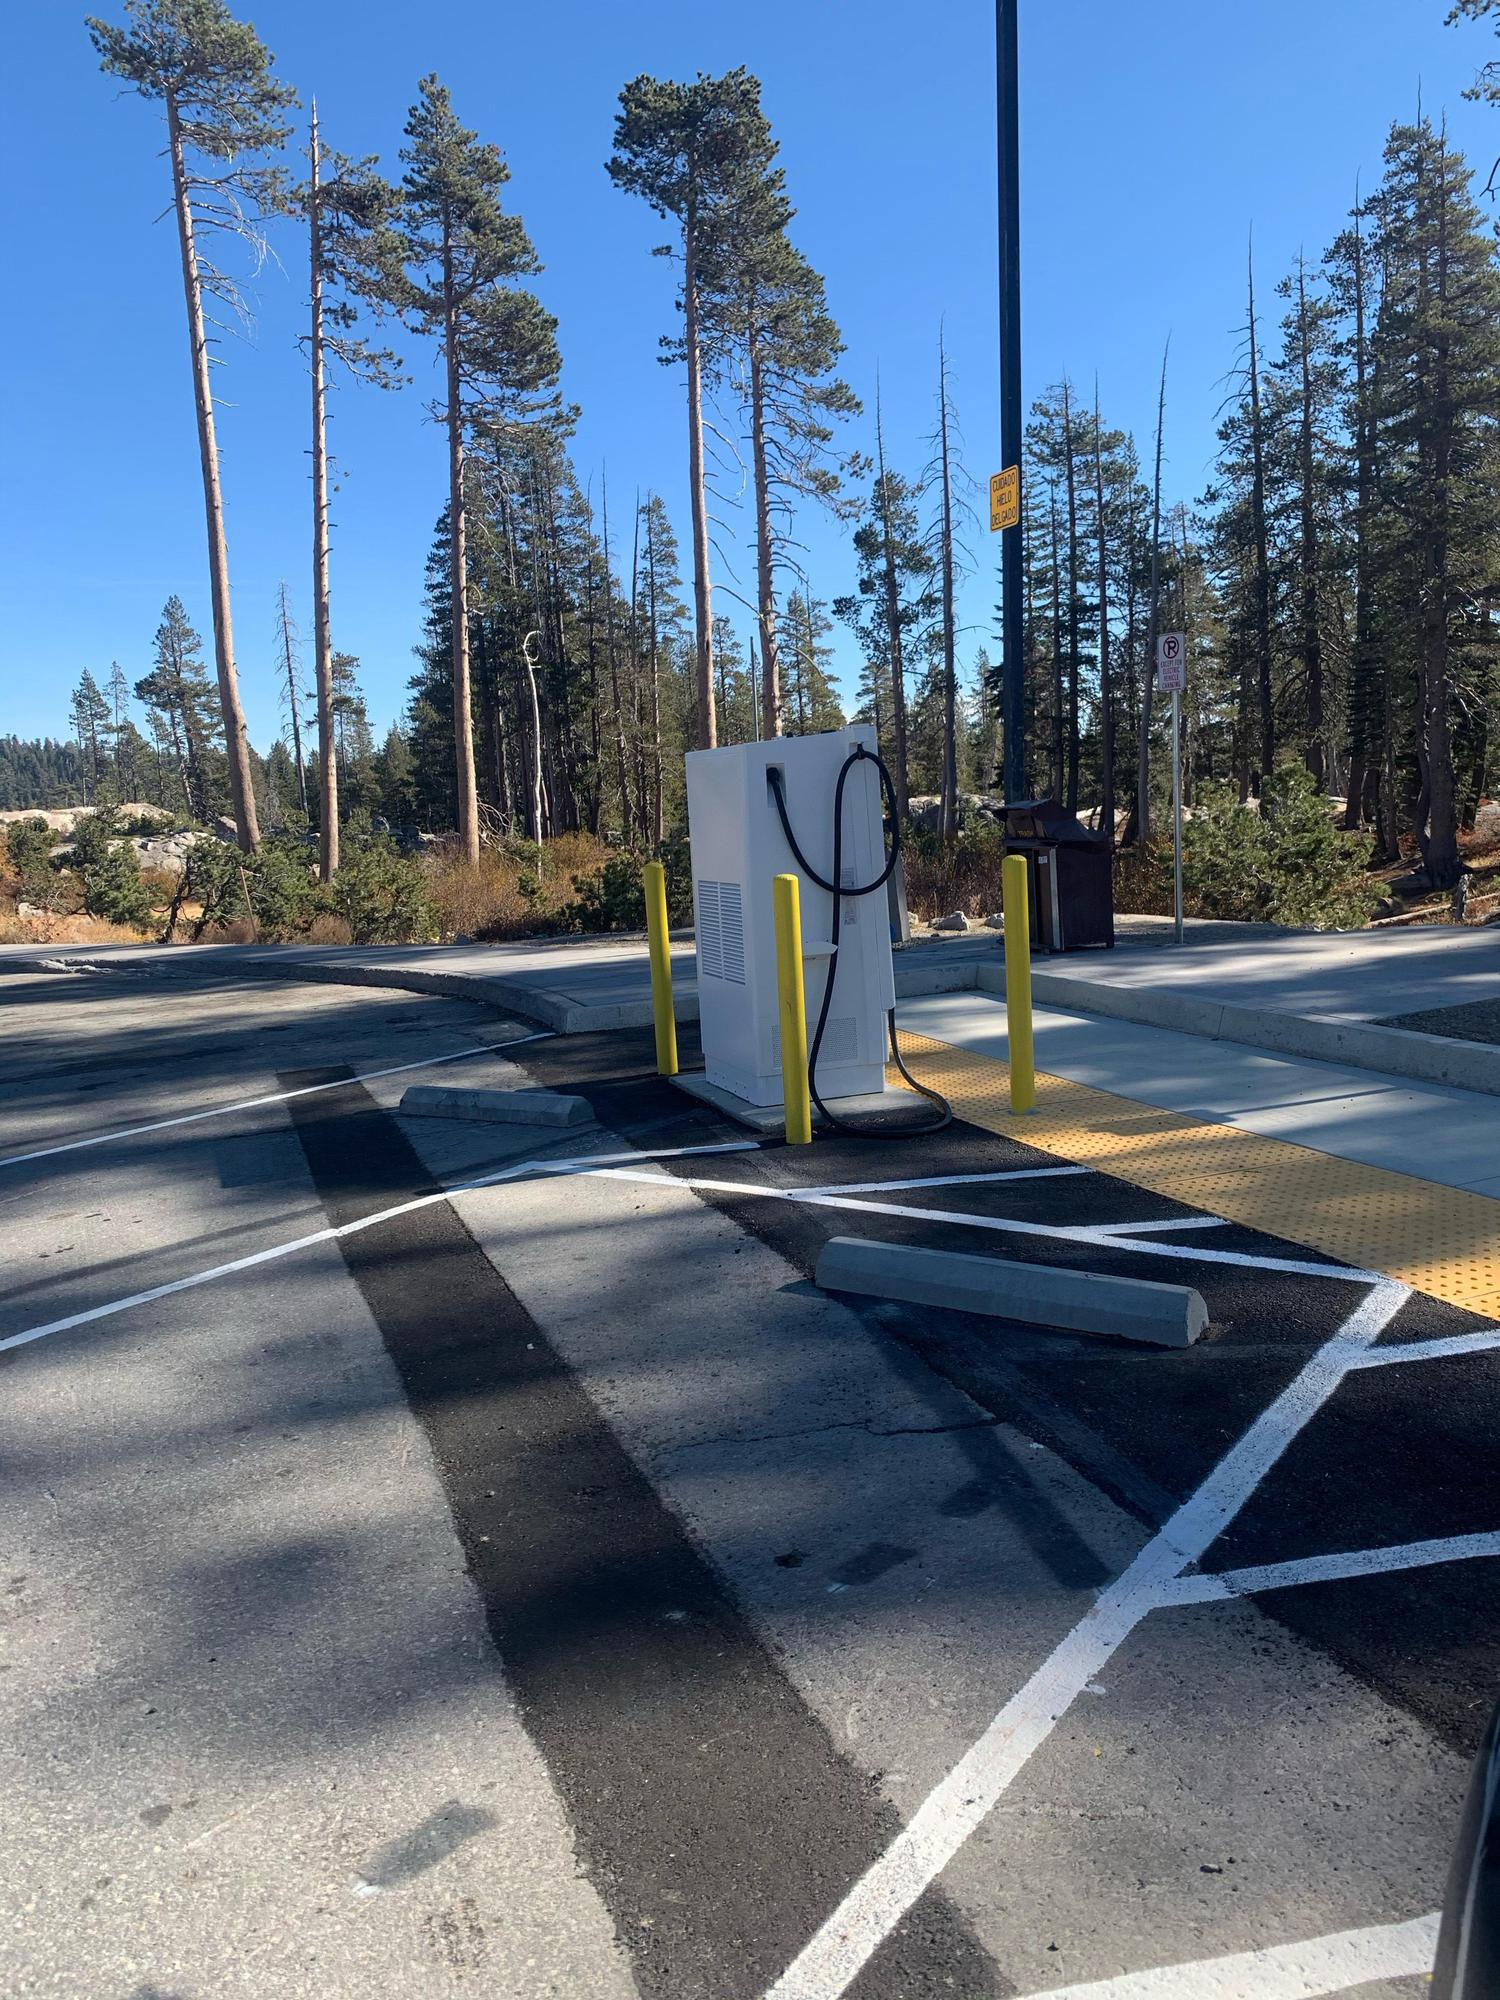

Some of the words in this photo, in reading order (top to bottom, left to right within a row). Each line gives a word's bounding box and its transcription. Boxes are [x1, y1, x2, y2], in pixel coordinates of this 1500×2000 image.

[993, 472, 1015, 492] CUIDADO
[997, 491, 1011, 507] HIELO
[992, 507, 1016, 526] DELGADO
